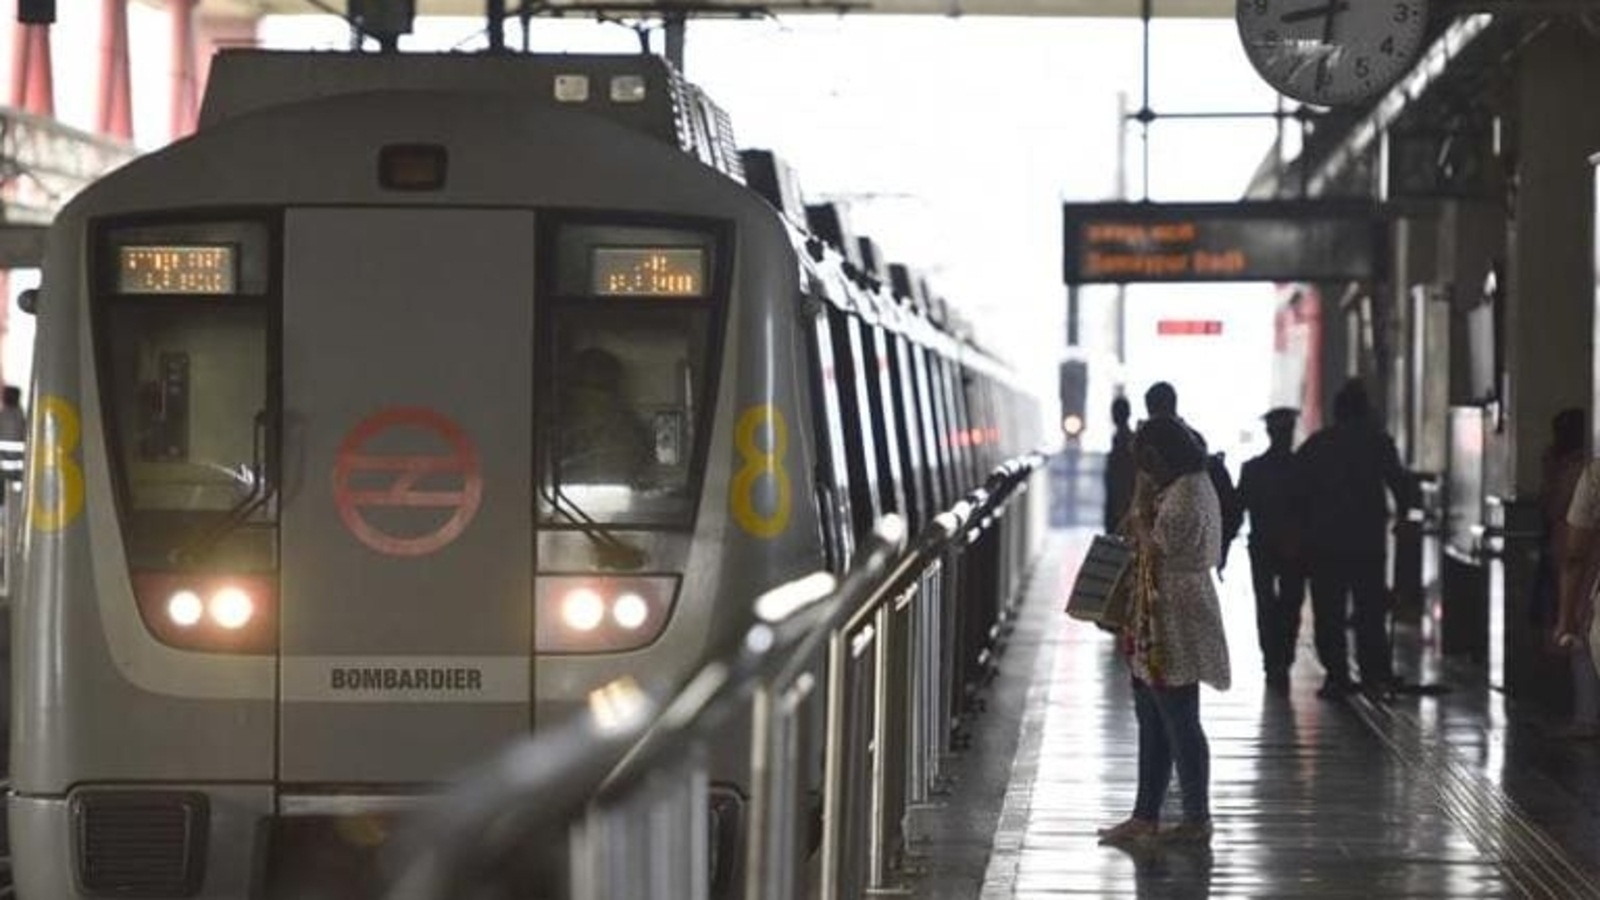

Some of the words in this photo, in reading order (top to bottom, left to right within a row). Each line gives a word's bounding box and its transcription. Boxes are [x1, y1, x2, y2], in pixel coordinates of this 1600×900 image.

[1393, 3, 1409, 23] 3
[1380, 35, 1394, 57] 4
[1354, 57, 1369, 79] 5
[730, 404, 792, 538] 8
[331, 668, 482, 690] BOMBARDIER
